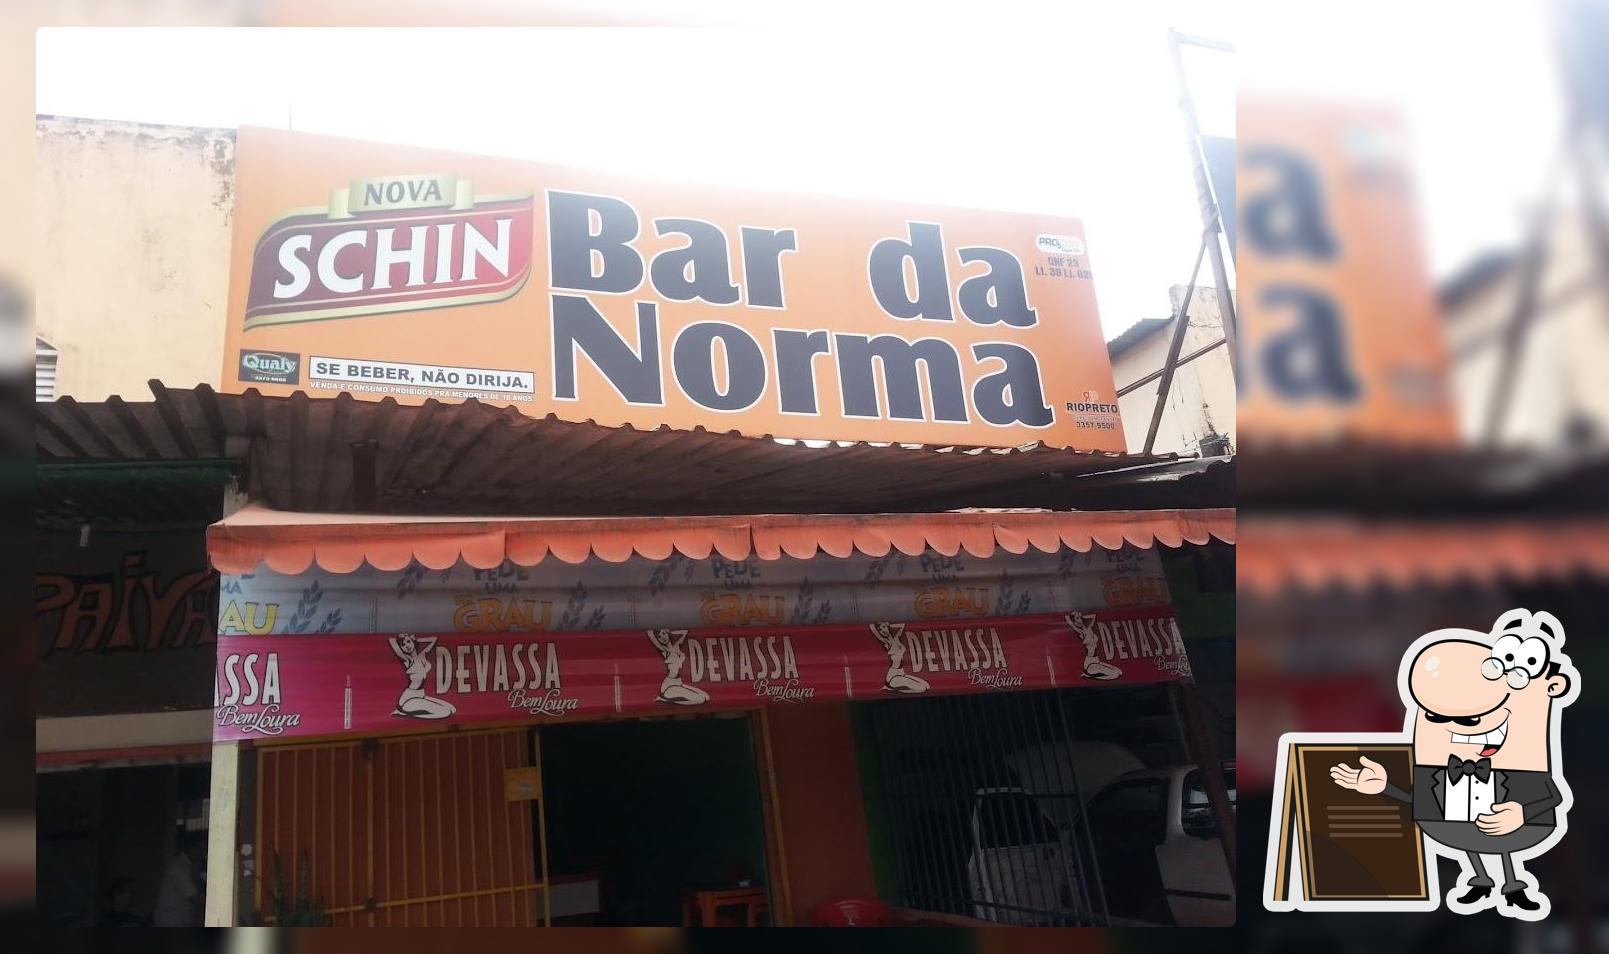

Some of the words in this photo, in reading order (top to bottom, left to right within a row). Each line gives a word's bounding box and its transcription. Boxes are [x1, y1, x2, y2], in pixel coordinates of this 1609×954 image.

[363, 179, 443, 206] NOVA
[273, 218, 513, 299] SCHIN
[545, 189, 798, 310] Bar
[866, 220, 1038, 329] da
[242, 354, 298, 374] Qualy
[316, 362, 341, 375] SE
[347, 365, 415, 383] BEBER,
[421, 369, 460, 384] NÃO
[466, 373, 529, 389] DIRIJA.
[548, 292, 1056, 430] Norma
[310, 381, 338, 390] VENDA
[347, 384, 388, 393] CONSUMO
[390, 386, 433, 396] PROIBIDOS
[452, 391, 489, 400] MENORES
[512, 395, 533, 403] ANOS
[1066, 402, 1119, 414] RIOPRETO
[453, 597, 553, 636] GRAU
[700, 592, 785, 627] GRAU
[914, 585, 990, 620] GRAU
[904, 627, 1008, 673] DEVASSA
[1097, 616, 1187, 661] DEVASSA
[435, 642, 561, 694] DEVASSA
[687, 634, 799, 683] DEVASSA
